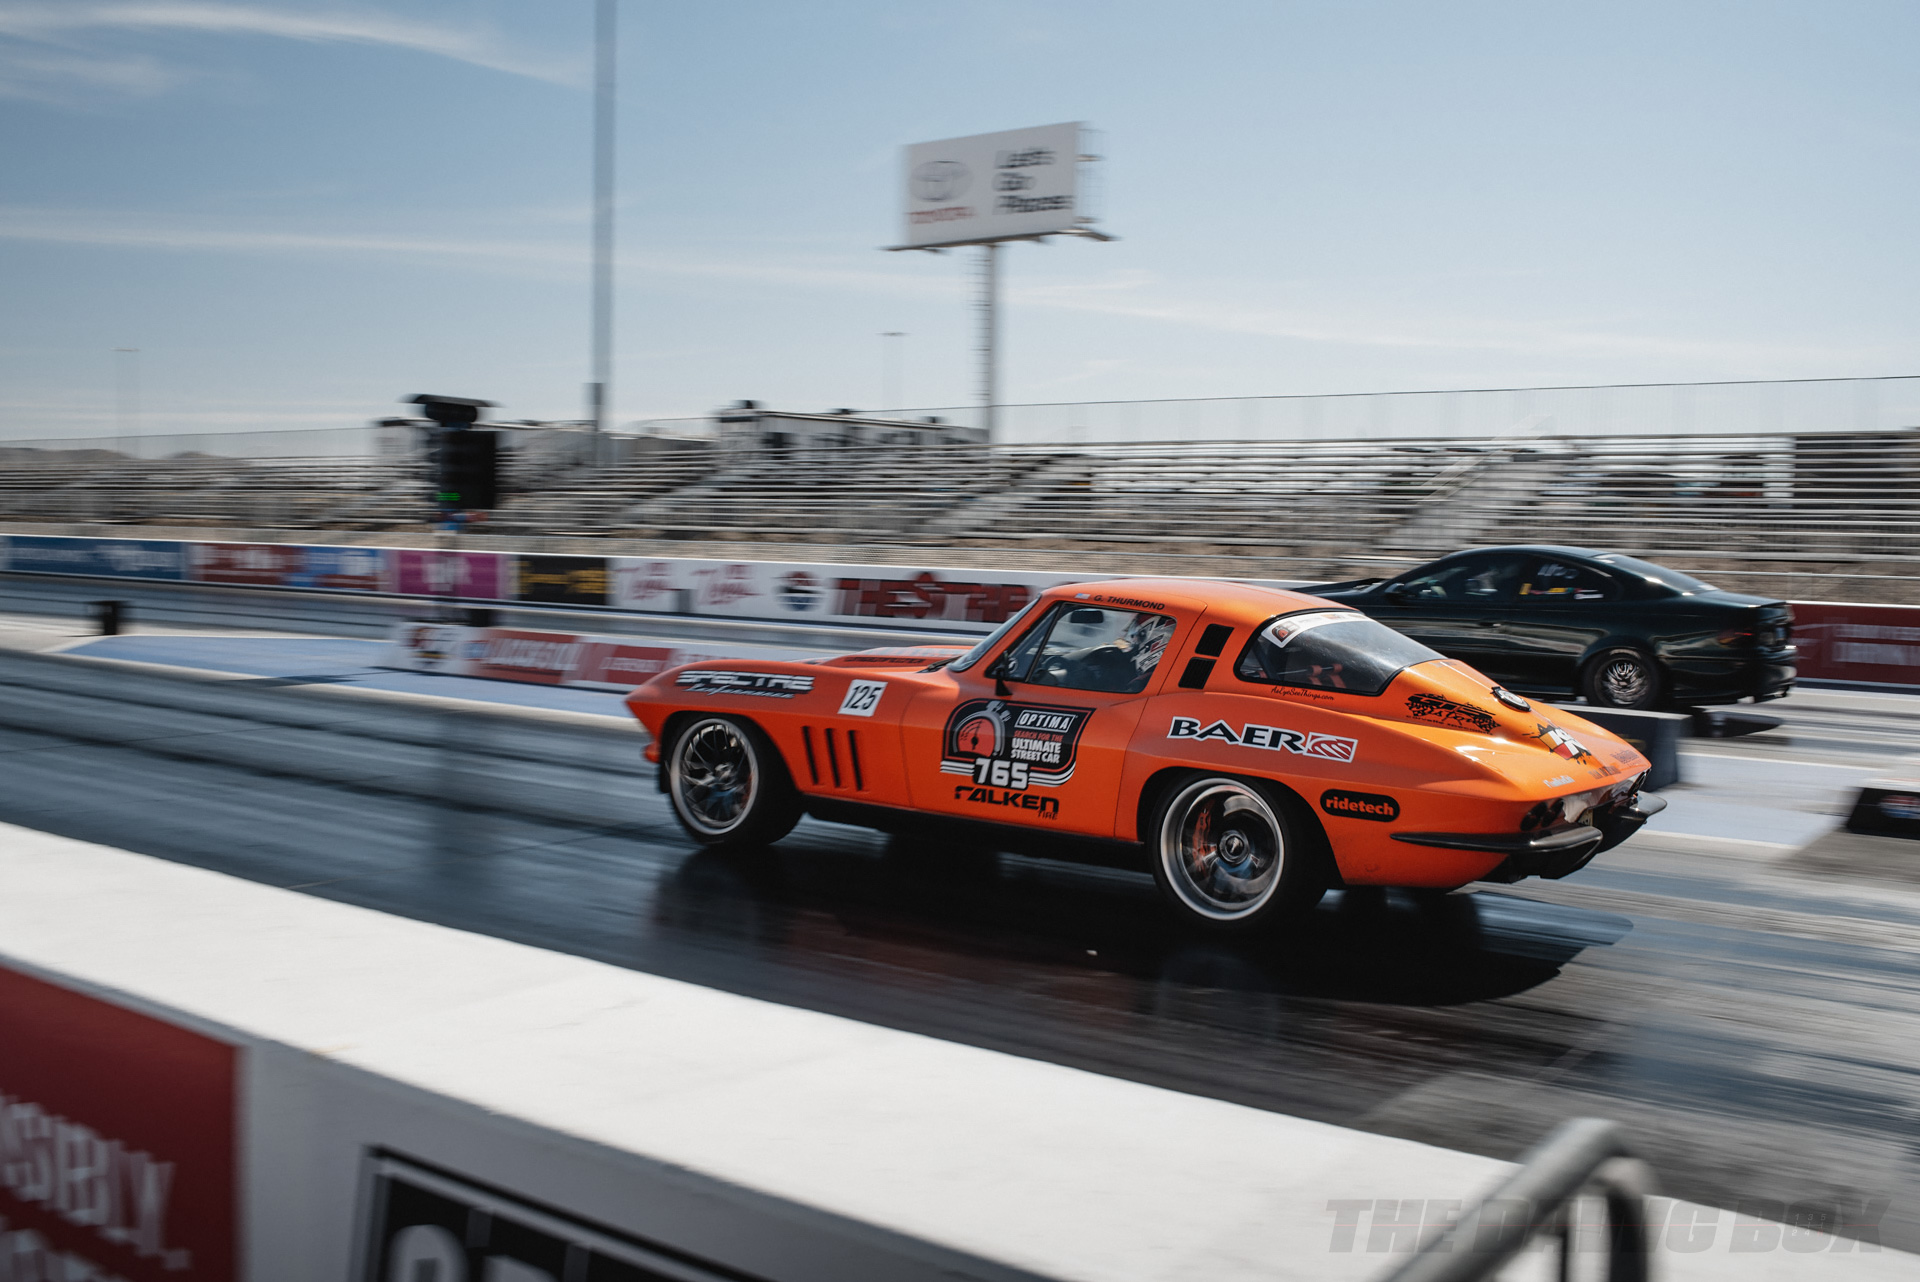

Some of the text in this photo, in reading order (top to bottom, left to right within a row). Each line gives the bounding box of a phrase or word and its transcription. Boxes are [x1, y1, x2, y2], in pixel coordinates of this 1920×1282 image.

[1107, 596, 1165, 610] THURMOND
[675, 670, 816, 692] SPECTRE
[843, 684, 881, 711] 125
[1019, 712, 1071, 730] OPTIMA
[1014, 730, 1064, 742] SEARCH FOR THE
[1168, 717, 1306, 753] BAER
[1010, 749, 1060, 763] STREET CAR
[1011, 738, 1062, 754] ULTIMATE
[975, 757, 1029, 790] 765
[954, 785, 1060, 814] FALKEN
[1325, 796, 1395, 817] ridetech
